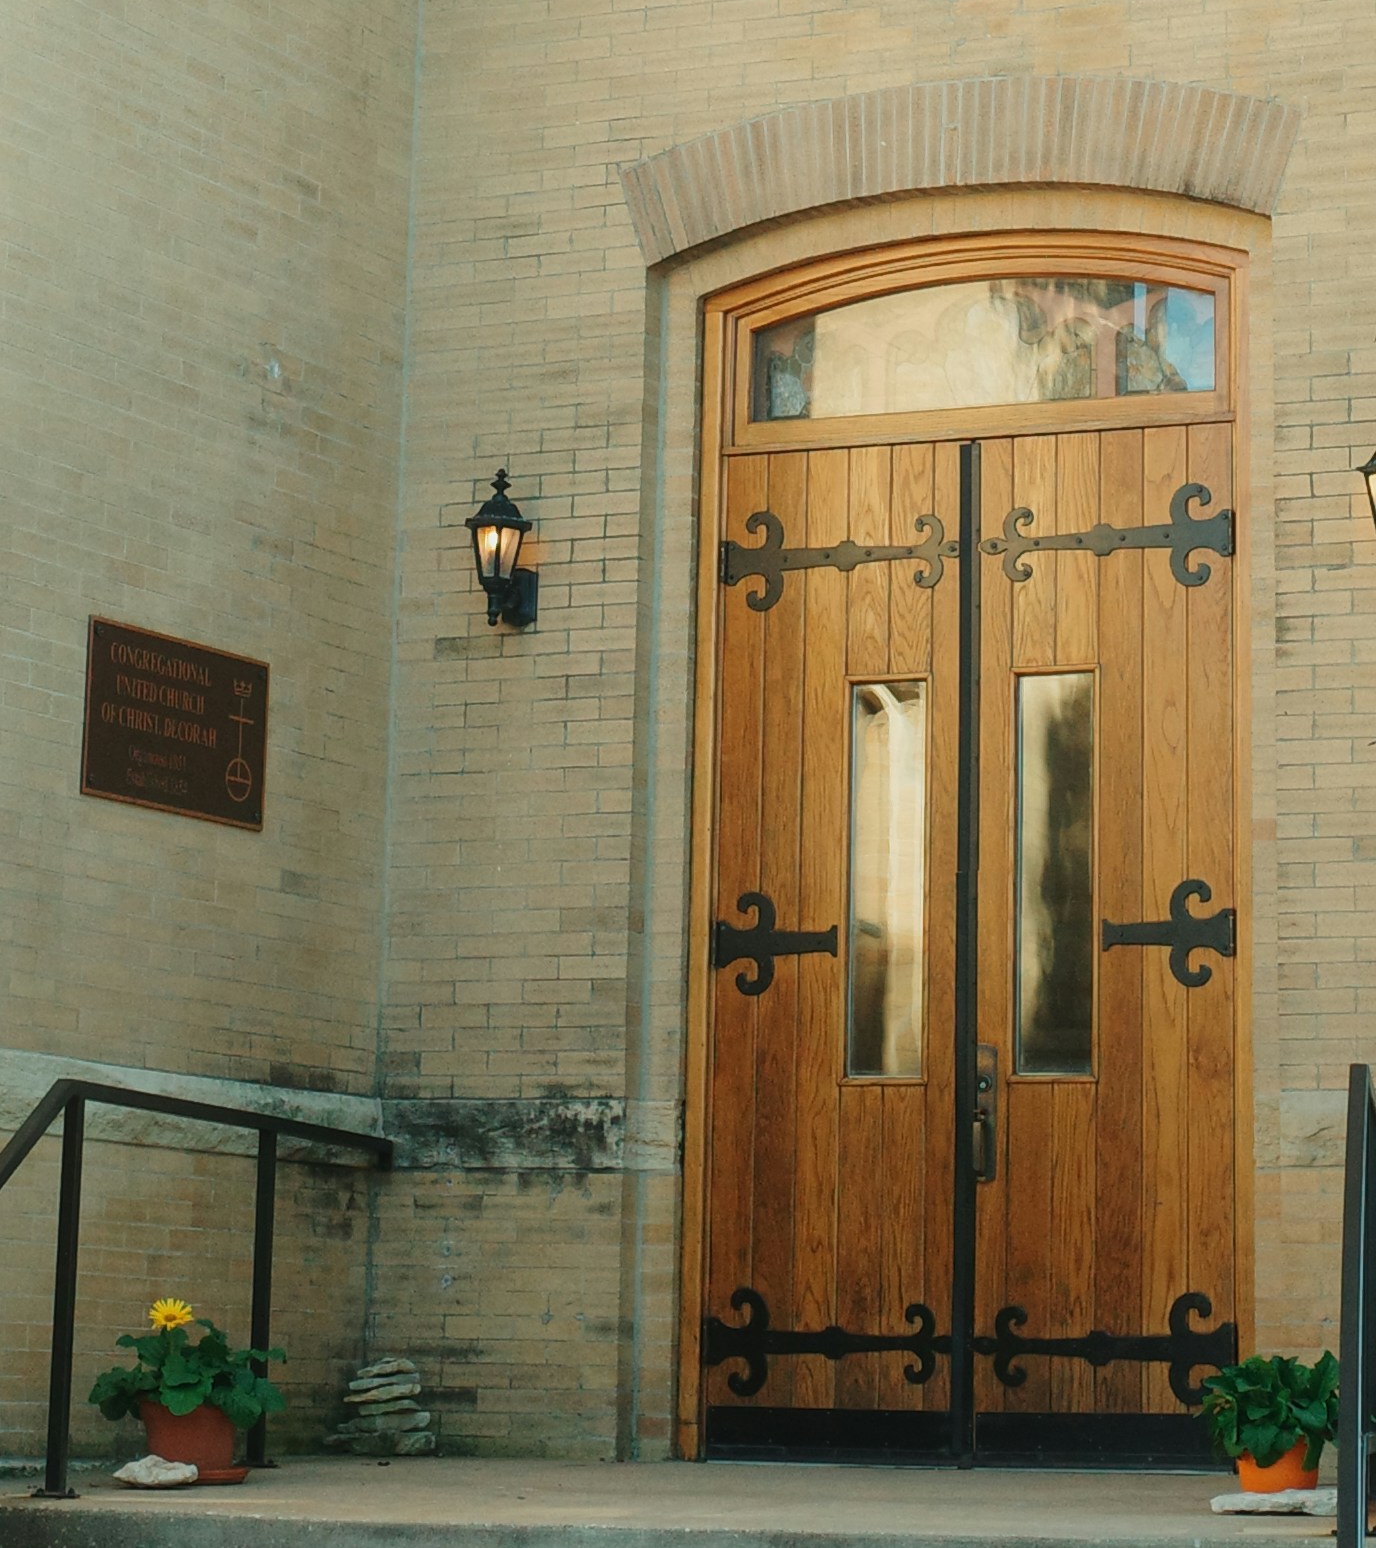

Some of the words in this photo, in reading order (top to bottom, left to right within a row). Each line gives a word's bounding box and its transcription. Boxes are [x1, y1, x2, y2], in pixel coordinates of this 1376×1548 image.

[110, 641, 212, 687] CONGREGATIONAL
[115, 673, 157, 703] UNITED
[159, 684, 205, 715] CHURCH
[101, 701, 116, 723] OF
[164, 717, 218, 749] DECORAH
